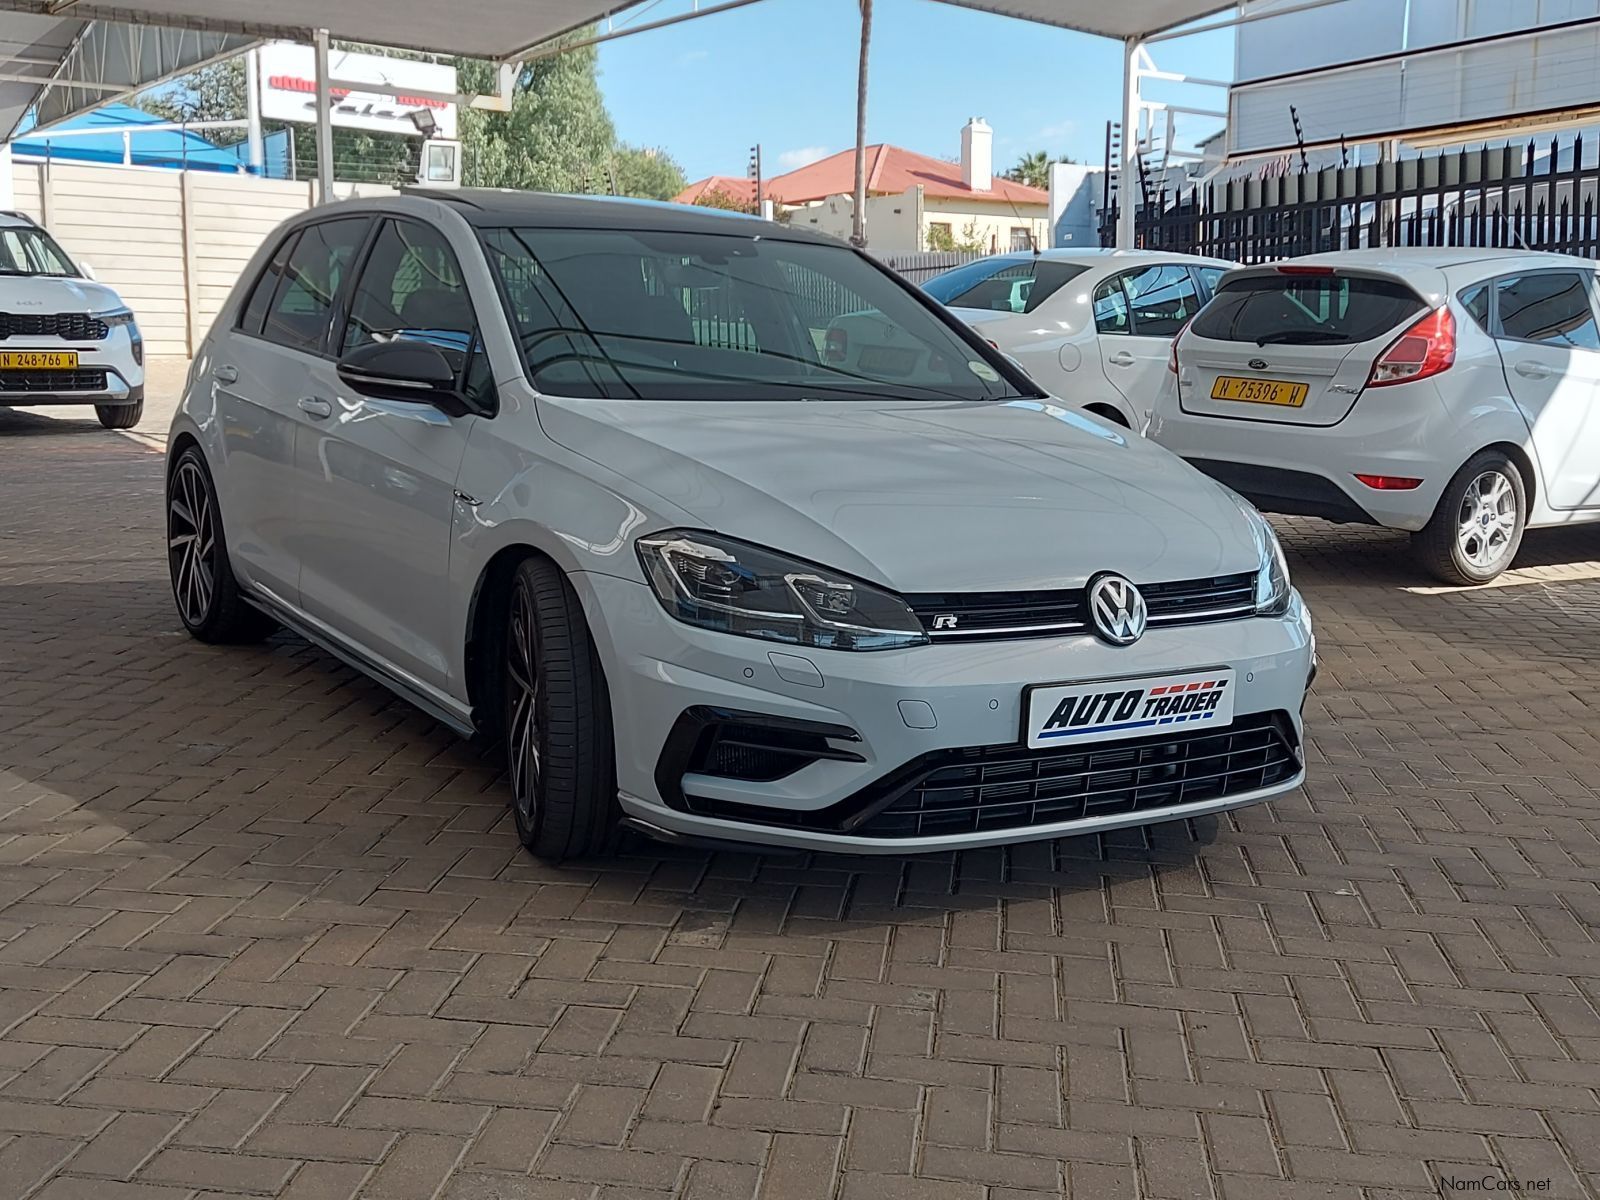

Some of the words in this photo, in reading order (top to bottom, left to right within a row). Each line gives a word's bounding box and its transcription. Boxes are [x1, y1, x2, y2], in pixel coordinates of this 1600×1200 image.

[3, 355, 10, 365] N
[68, 355, 74, 365] W
[1219, 379, 1229, 397] N
[1237, 380, 1278, 401] 75396
[1288, 386, 1302, 404] W
[932, 614, 957, 629] R
[1042, 689, 1145, 730] AUTO
[1141, 690, 1224, 719] TRADER
